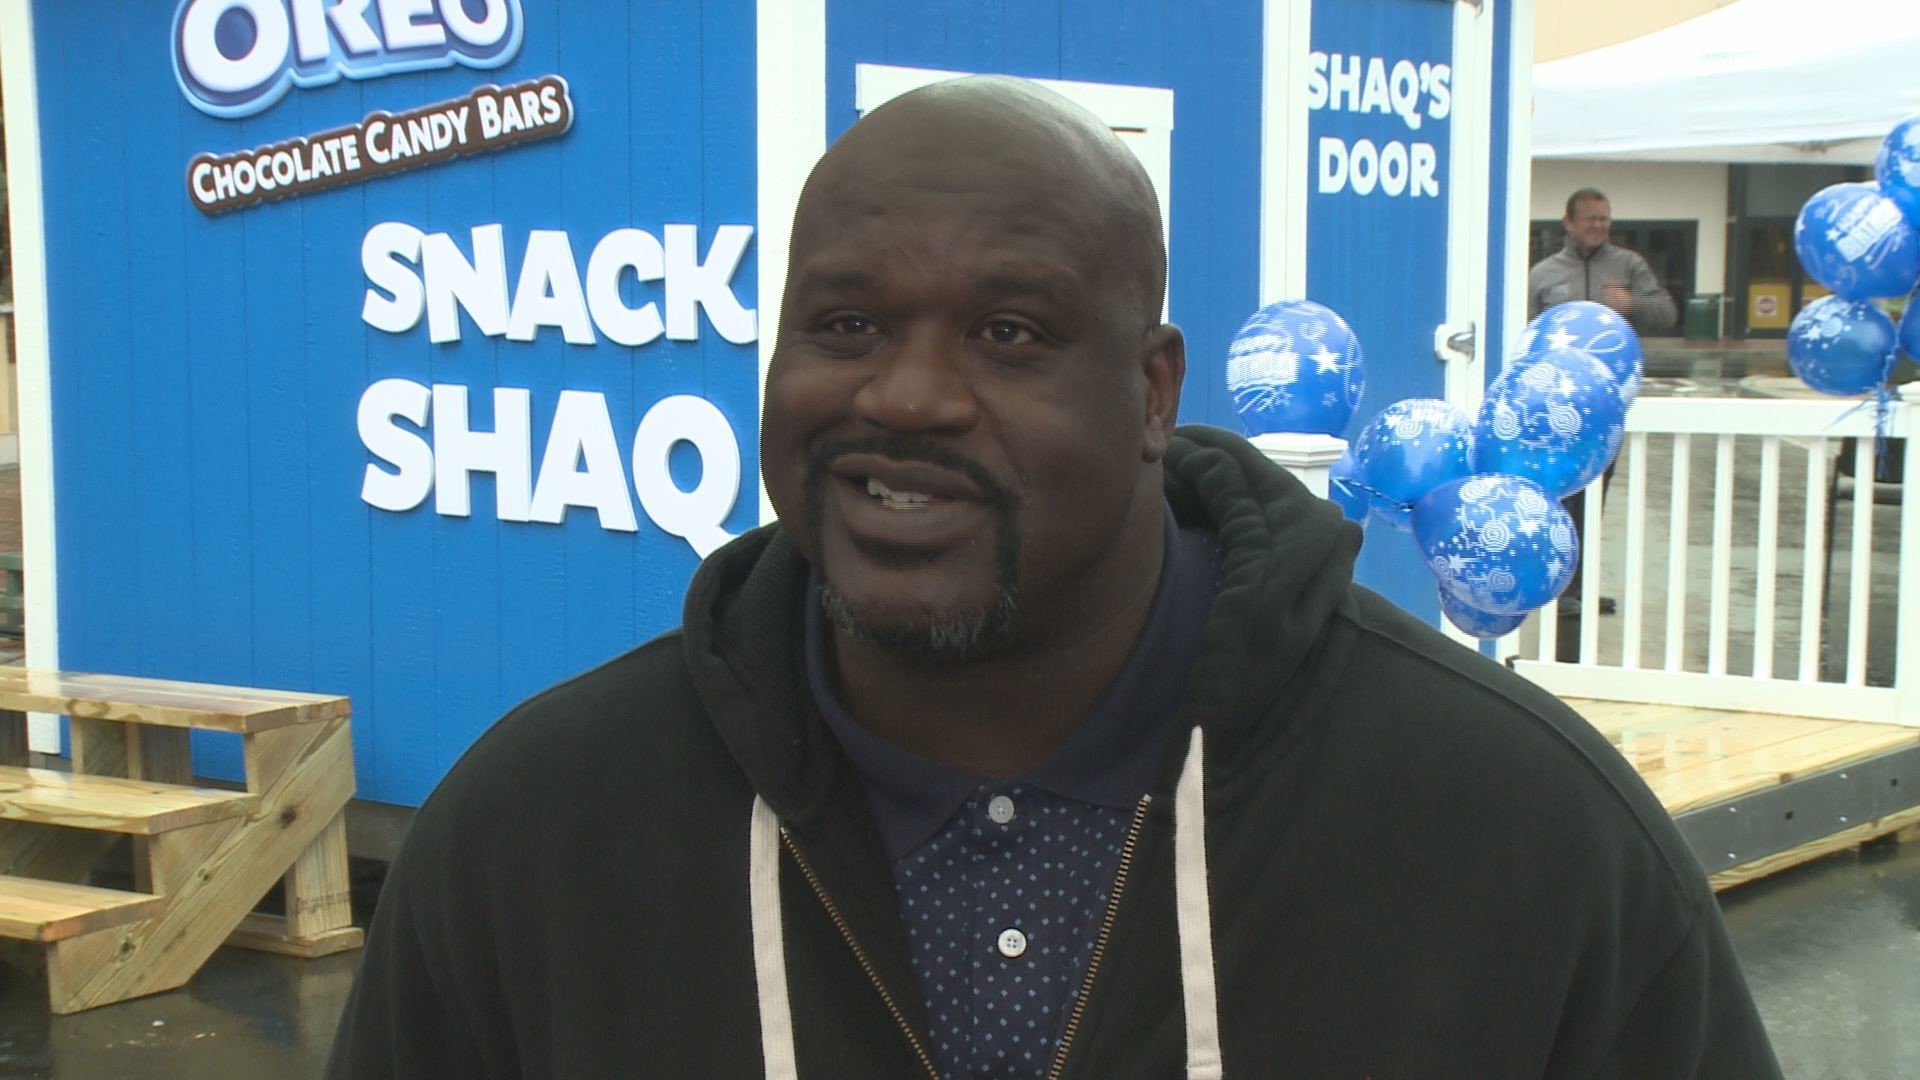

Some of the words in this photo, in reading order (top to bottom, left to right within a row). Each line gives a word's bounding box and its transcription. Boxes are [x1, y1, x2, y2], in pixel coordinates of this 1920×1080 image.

[192, 134, 358, 203] CHOCOLATE
[365, 106, 469, 164] CANDY
[478, 87, 561, 139] BARS
[1308, 51, 1451, 130] SHAQ'S
[1318, 137, 1439, 197] DOOR
[361, 222, 758, 346] SNACK
[357, 378, 742, 560] SHAQ
